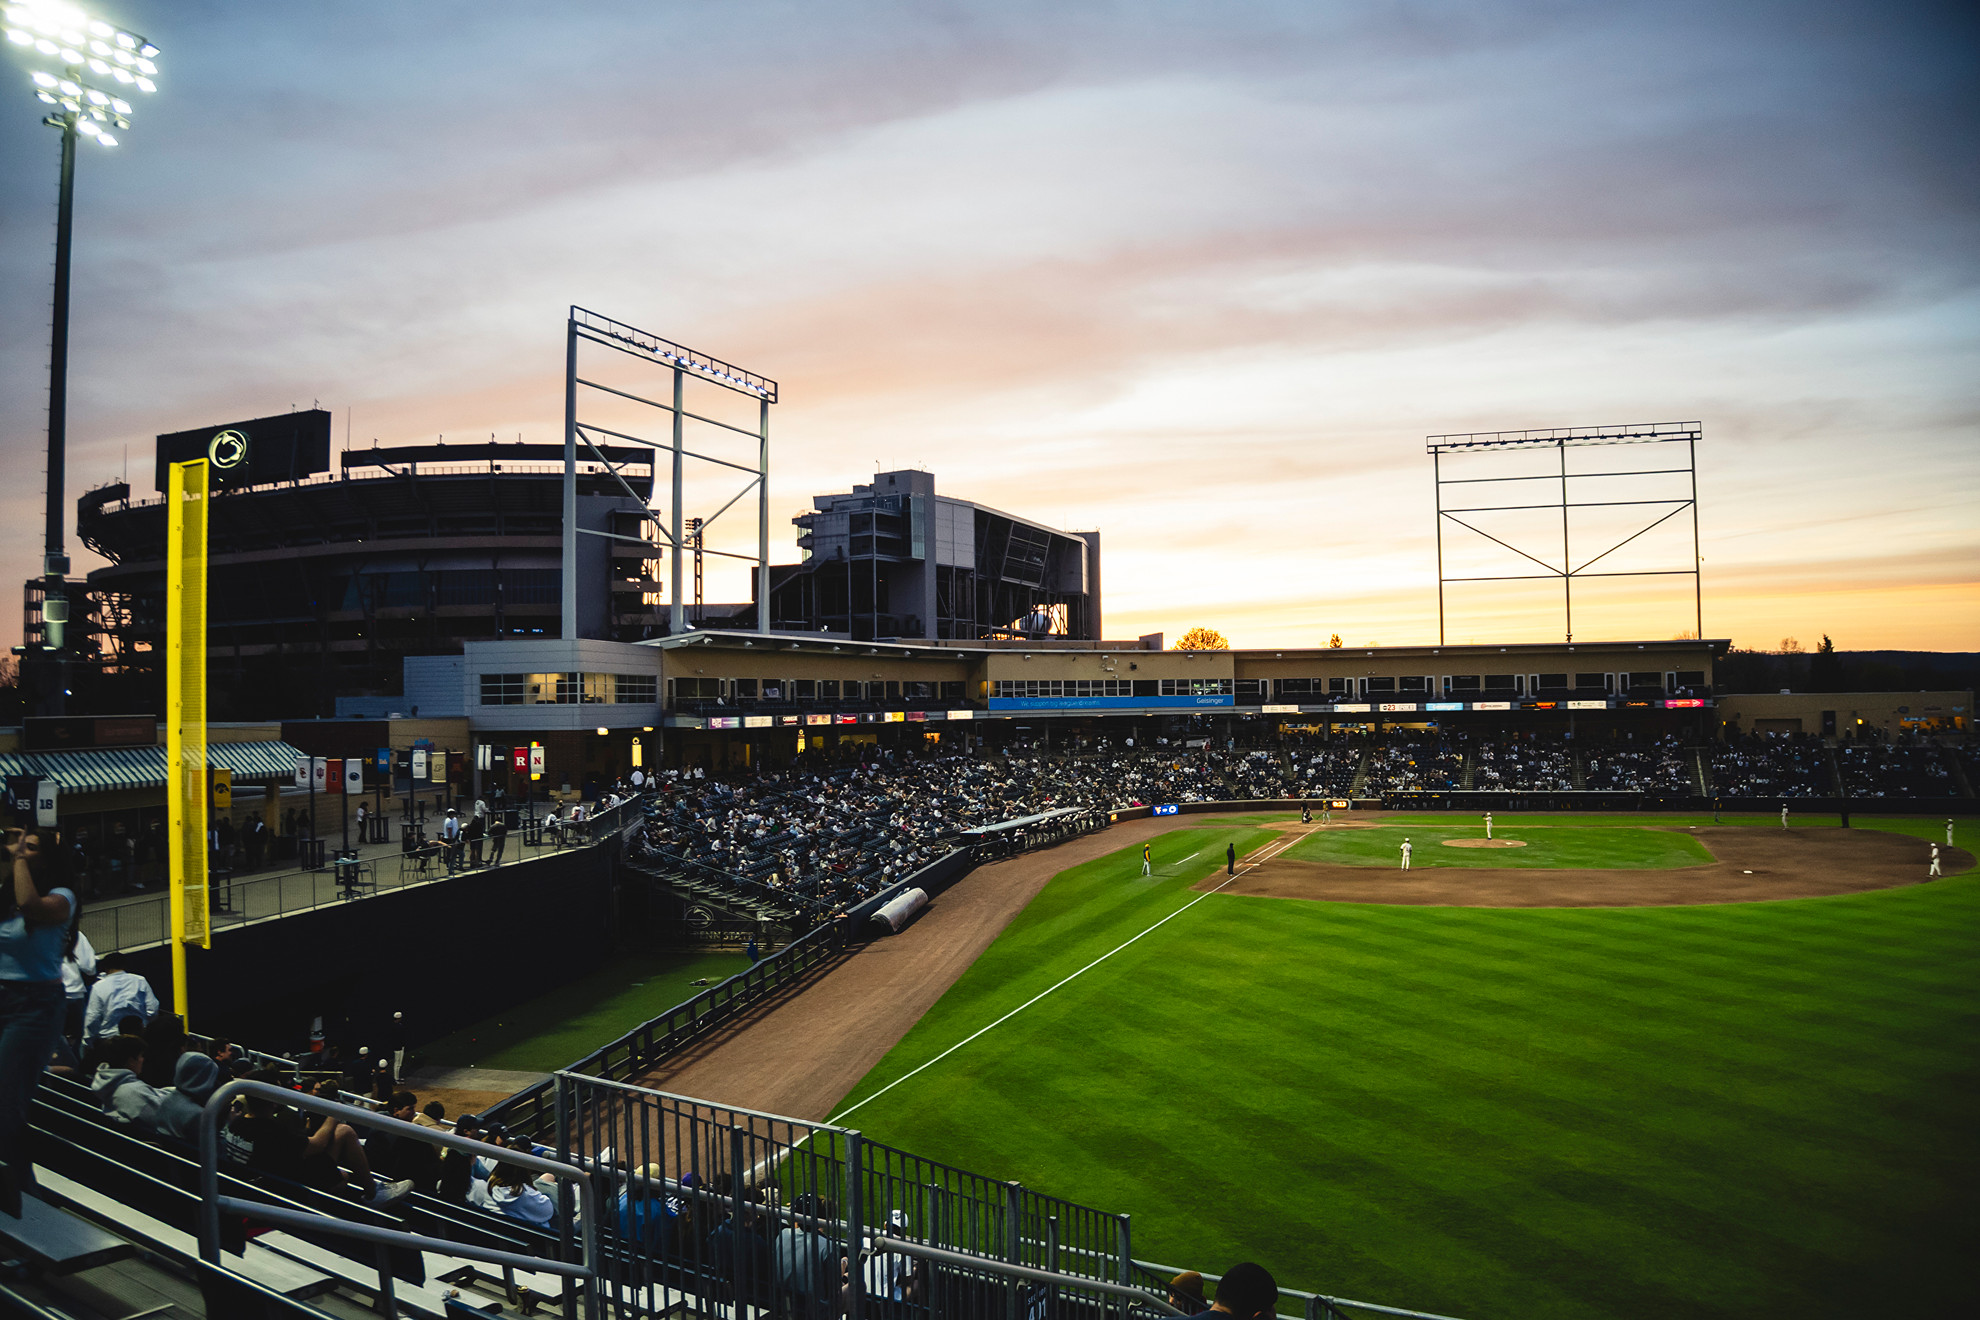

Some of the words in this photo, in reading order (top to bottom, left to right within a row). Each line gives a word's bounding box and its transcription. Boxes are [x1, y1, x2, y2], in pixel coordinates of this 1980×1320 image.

[1196, 697, 1225, 706] Geisinger
[365, 757, 373, 765] M
[516, 756, 527, 766] R
[534, 757, 542, 765] N
[17, 799, 31, 810] 55
[40, 799, 53, 809] 18
[690, 931, 721, 941] ENN
